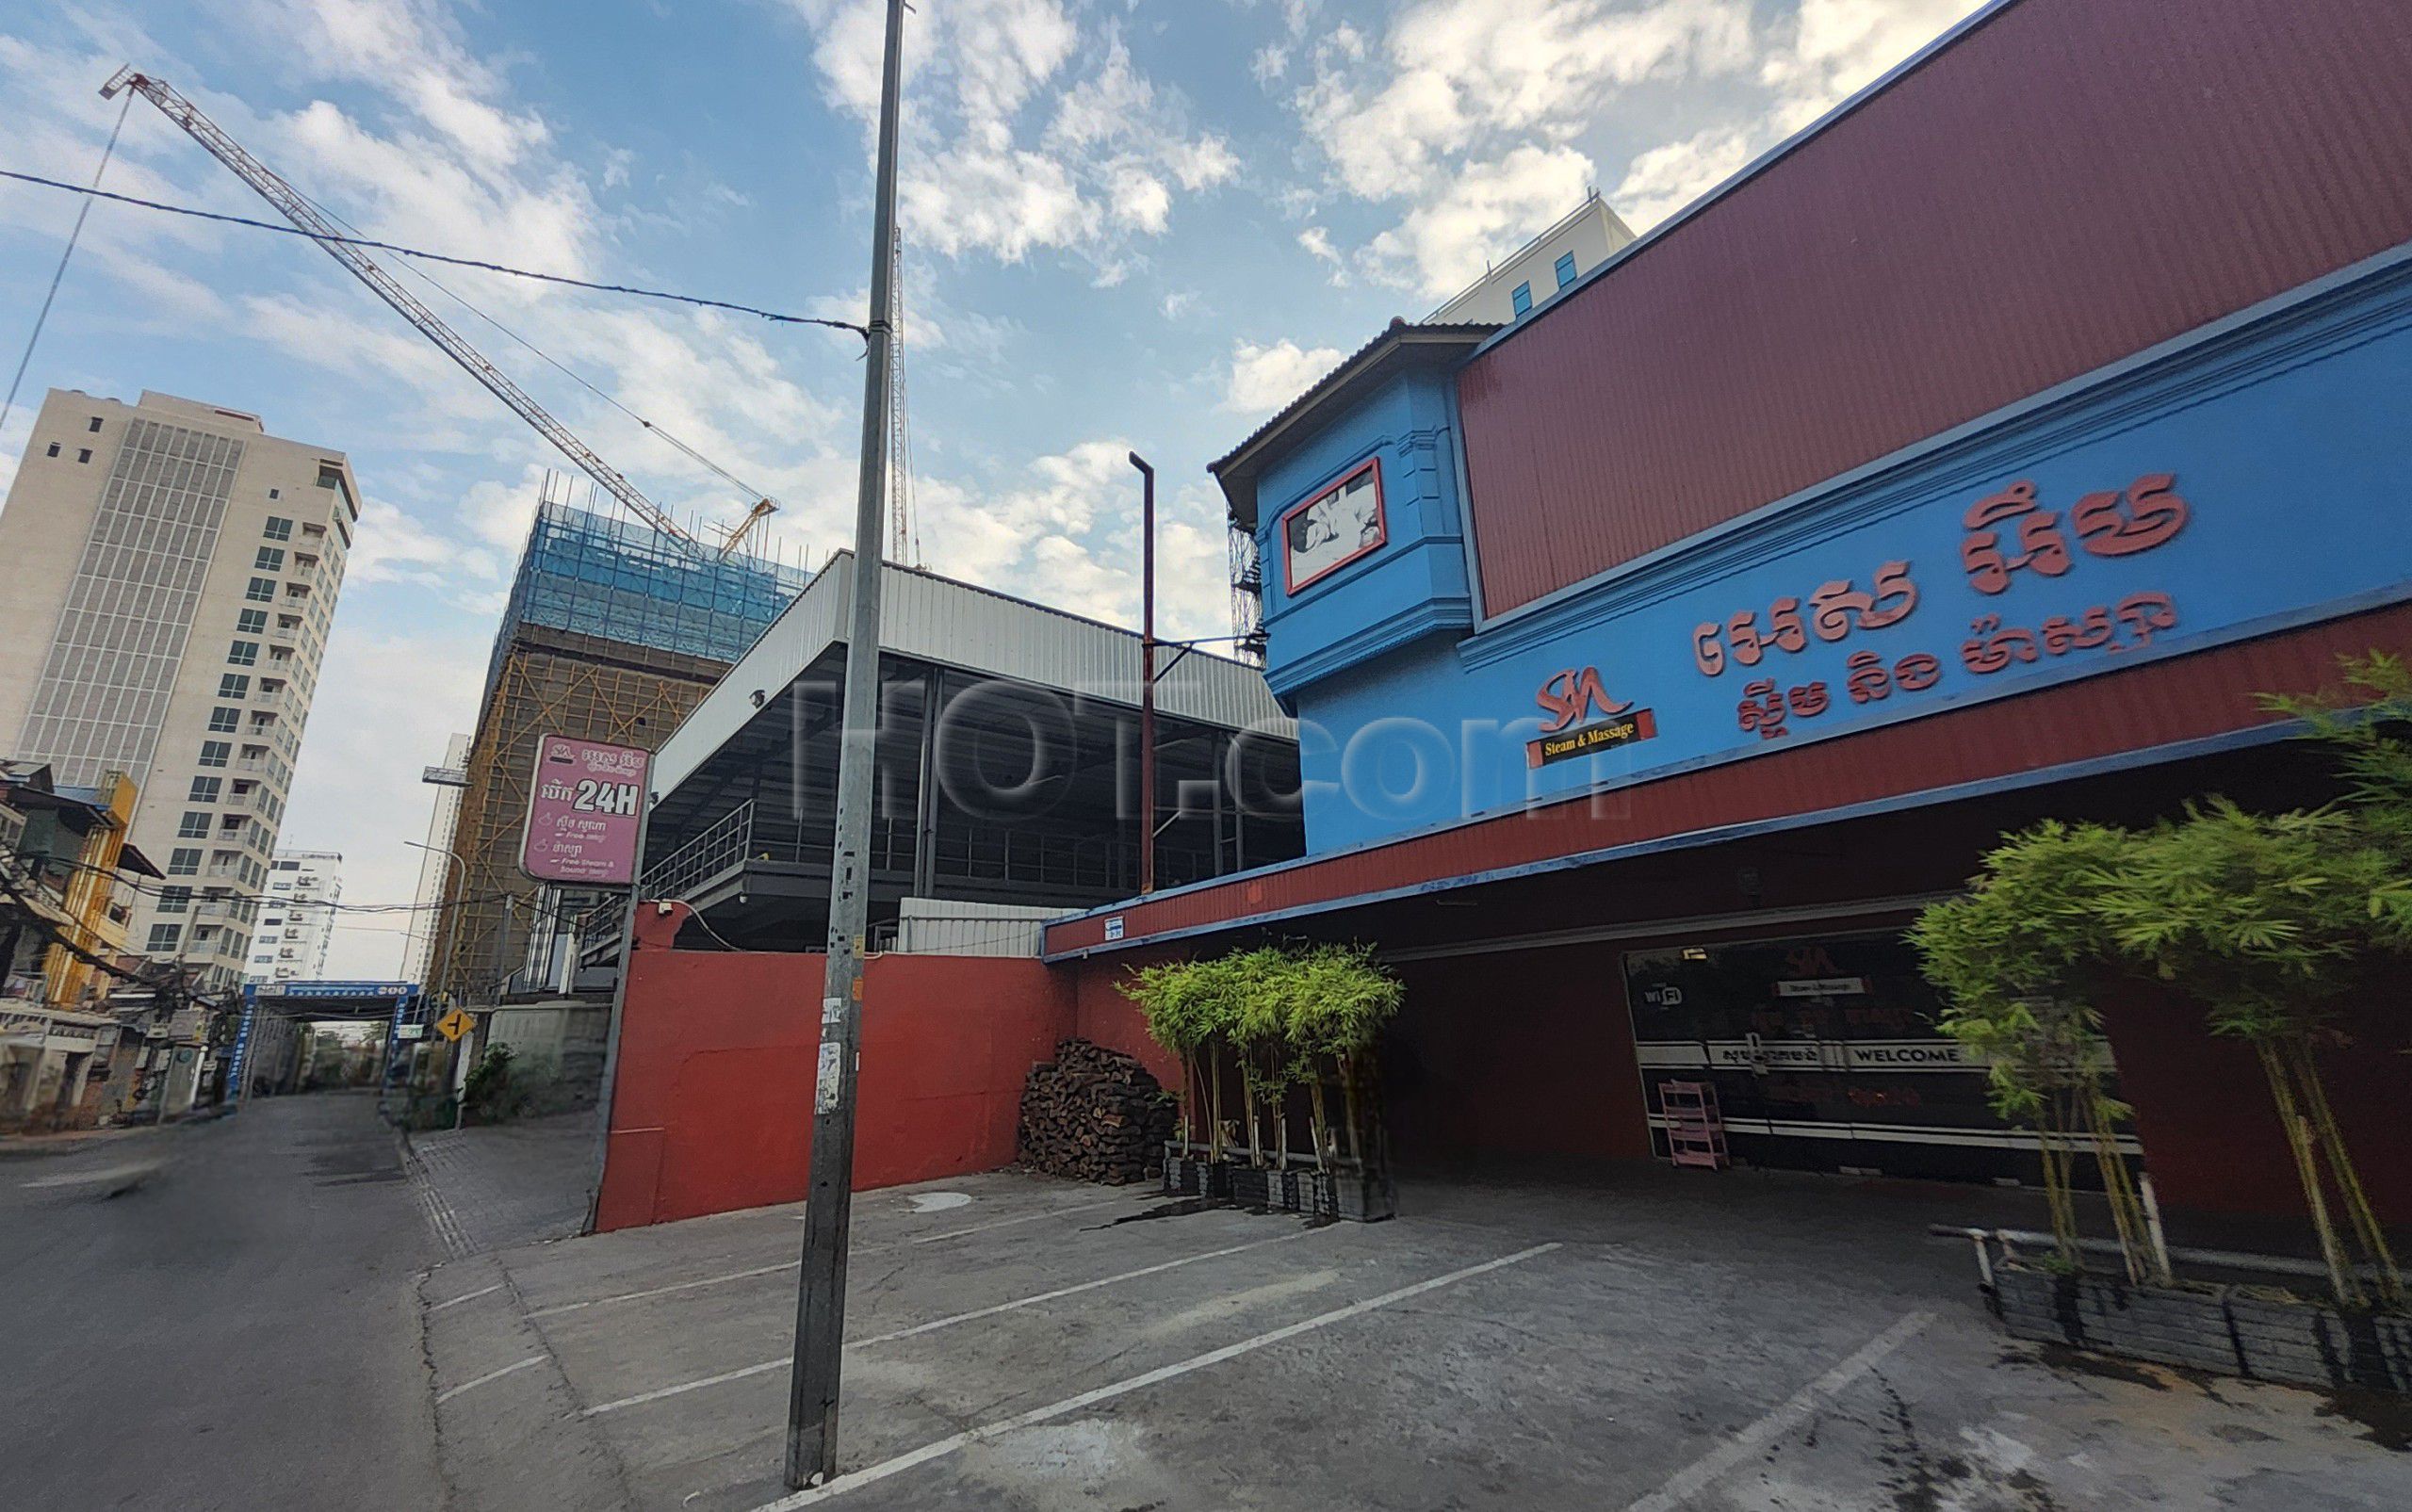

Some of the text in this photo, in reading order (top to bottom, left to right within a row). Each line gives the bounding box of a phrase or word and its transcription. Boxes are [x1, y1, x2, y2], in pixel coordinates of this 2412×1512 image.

[1847, 651, 1941, 704] និង
[1545, 723, 1634, 756] Steam & Massage
[541, 778, 574, 802] បើក
[573, 778, 639, 816] 24H
[1854, 1048, 1960, 1063] WELCOME
